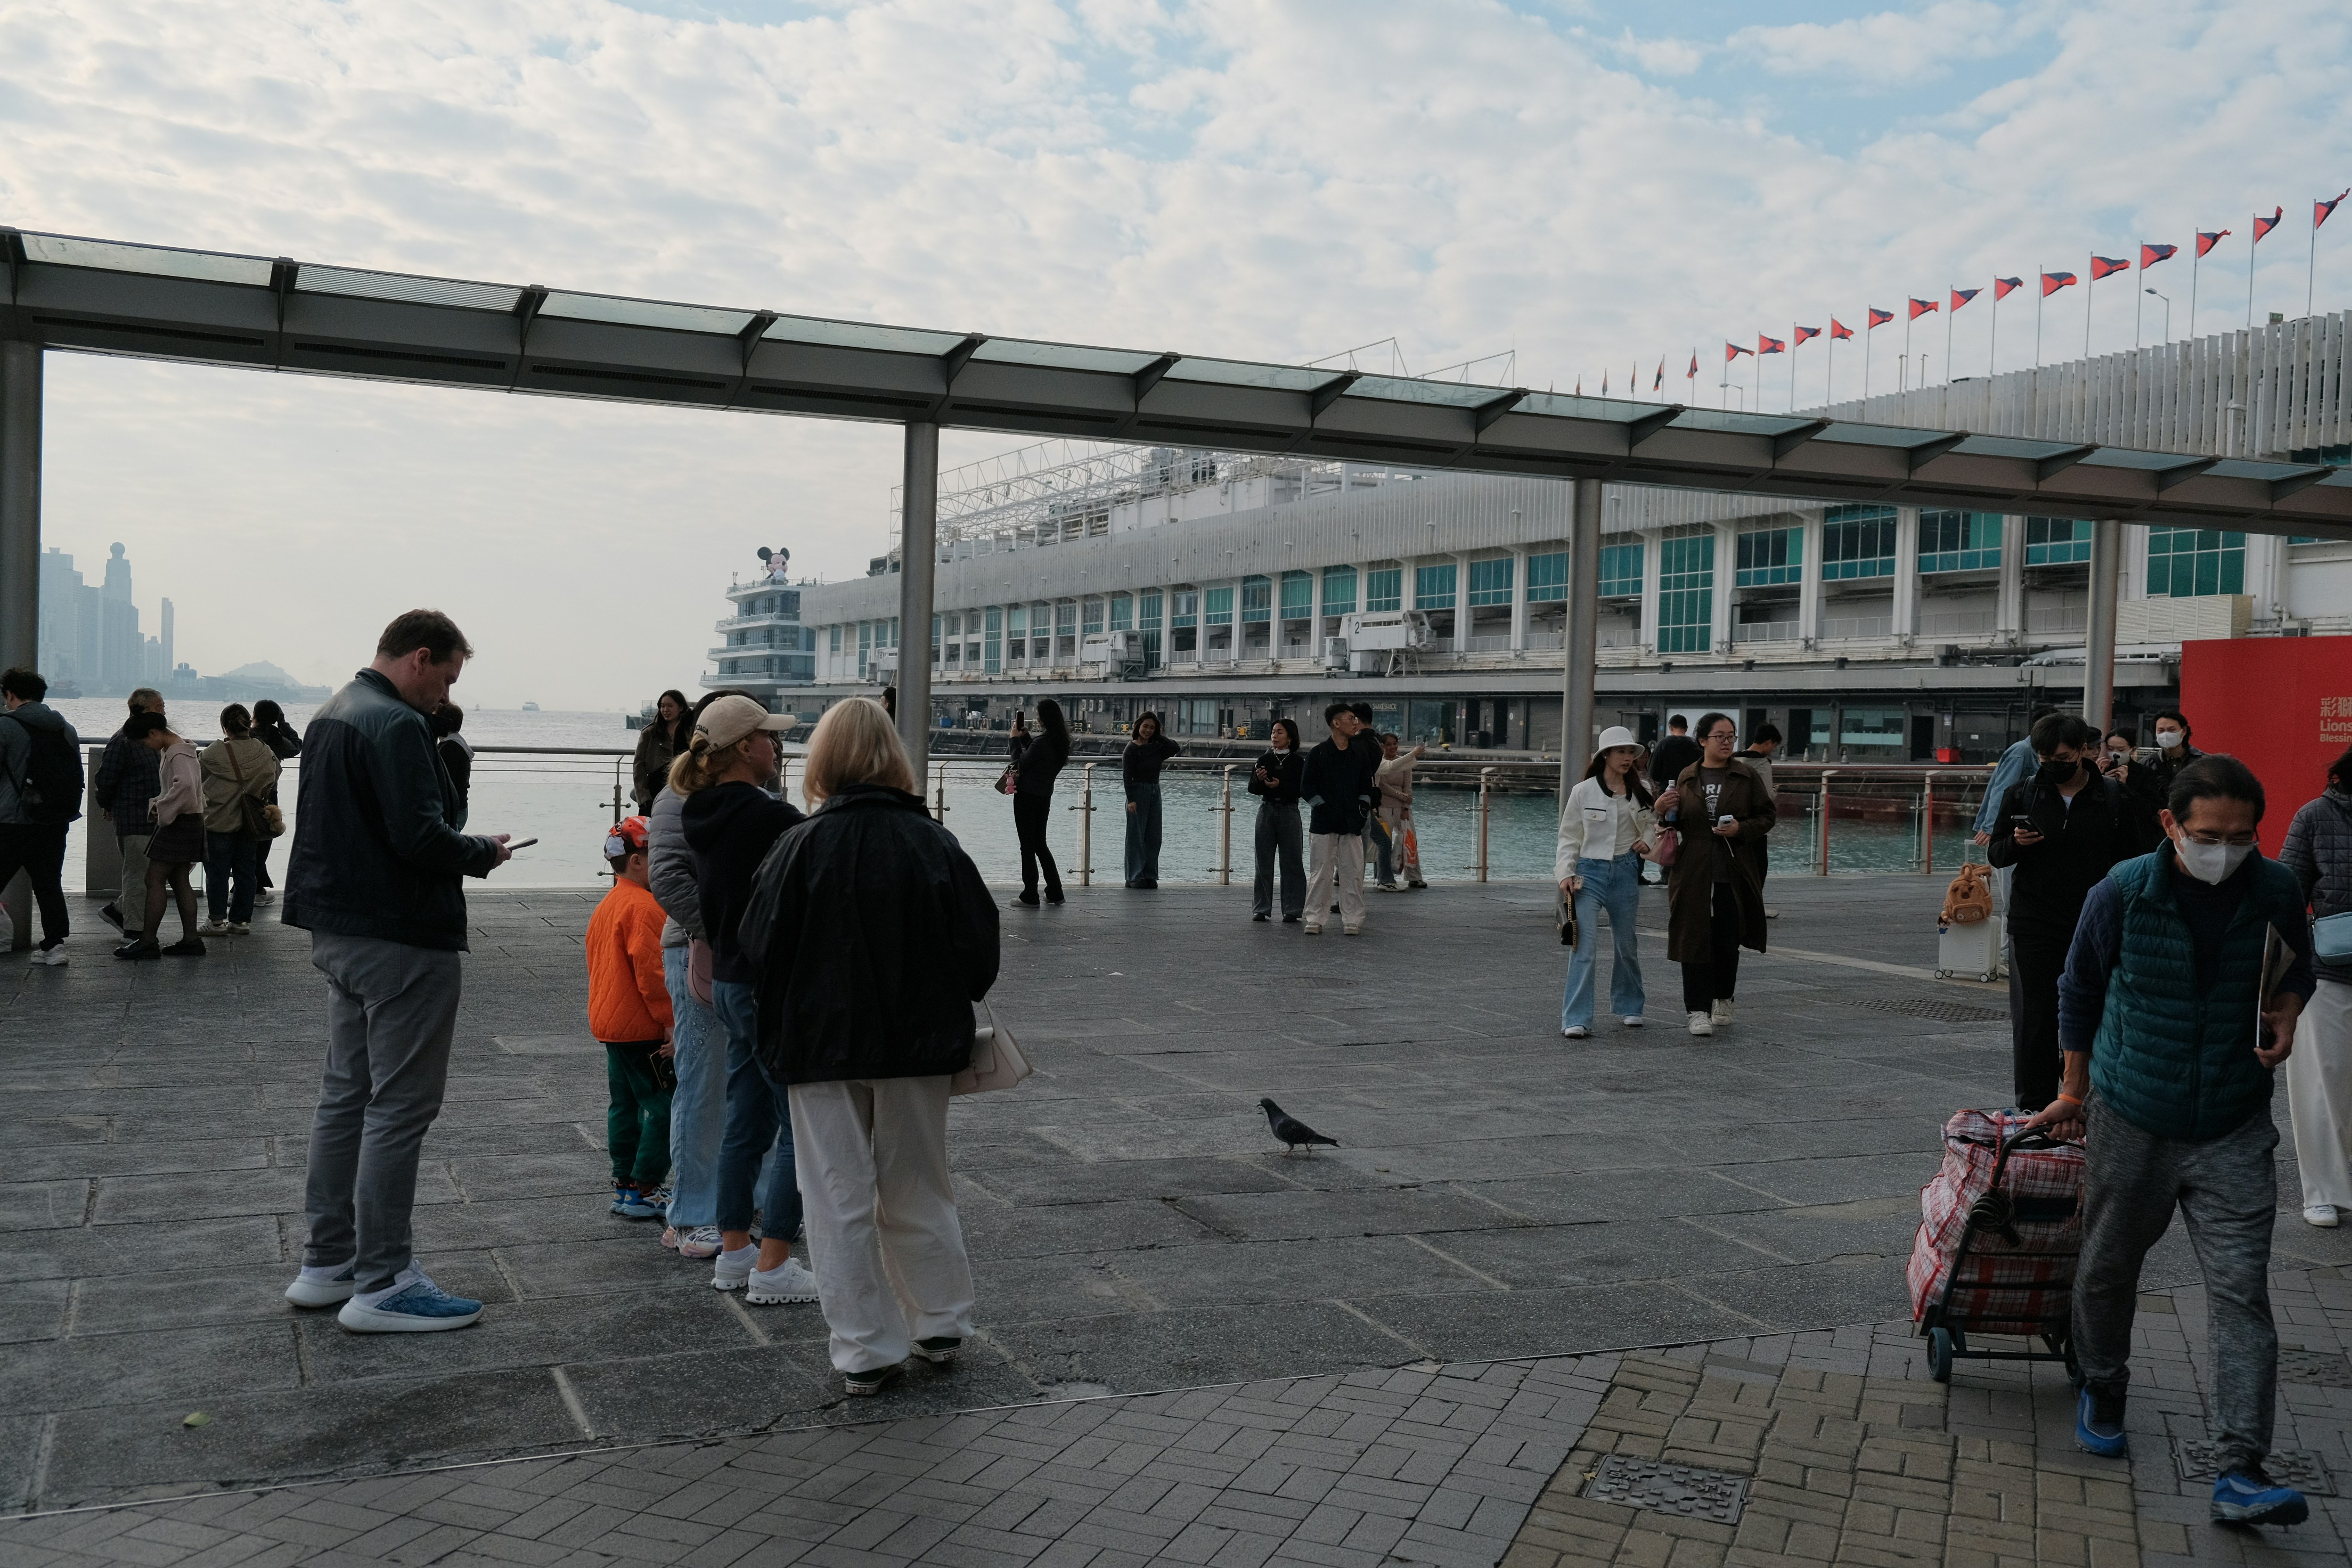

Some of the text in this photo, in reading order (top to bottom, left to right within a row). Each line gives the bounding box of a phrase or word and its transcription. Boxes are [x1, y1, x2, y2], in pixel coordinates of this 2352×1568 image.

[1354, 621, 1360, 634] 2
[2321, 718, 2352, 732] Lions
[1702, 784, 1721, 794] RI
